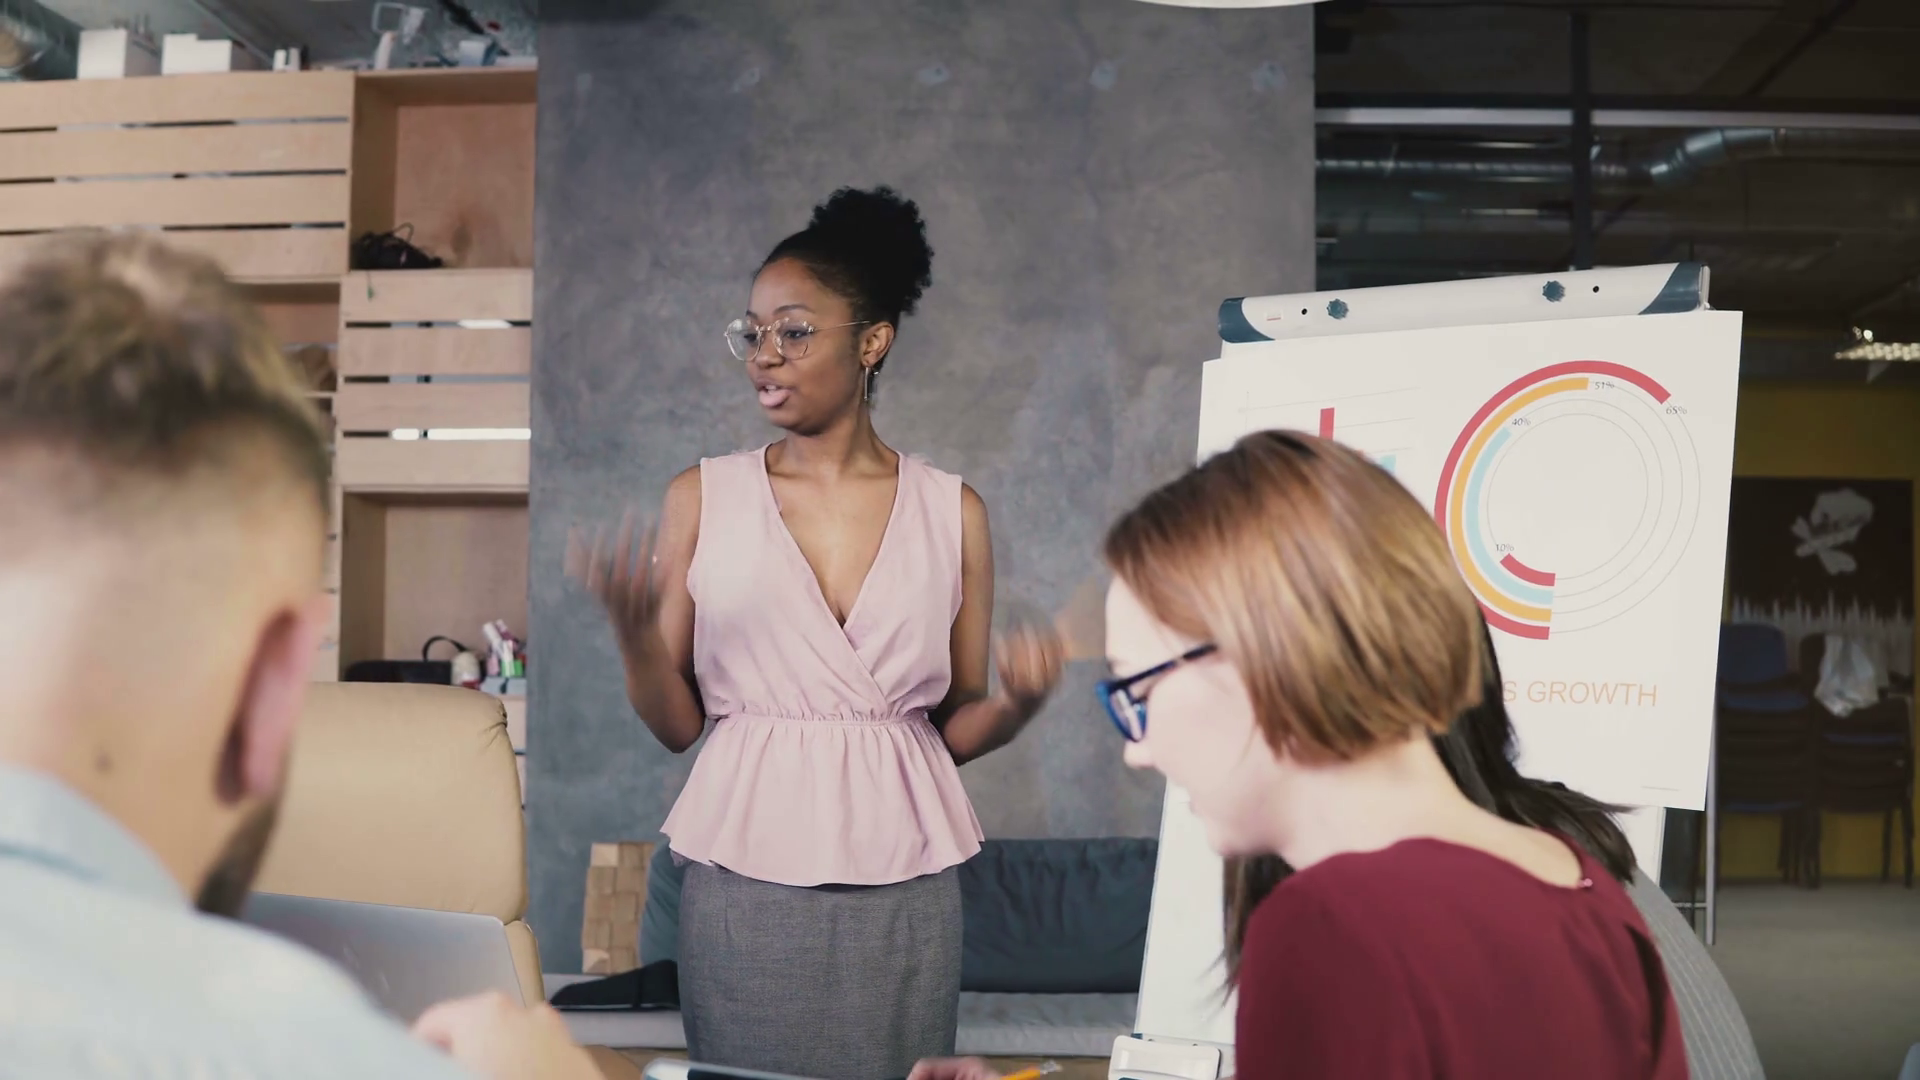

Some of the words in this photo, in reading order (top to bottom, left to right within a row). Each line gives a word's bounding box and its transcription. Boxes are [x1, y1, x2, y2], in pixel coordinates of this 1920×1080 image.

[1594, 381, 1615, 390] 51%
[1665, 405, 1688, 415] 65%
[1511, 417, 1531, 426] 40%
[1496, 543, 1515, 552] 10%
[1527, 681, 1657, 707] GROWTH
